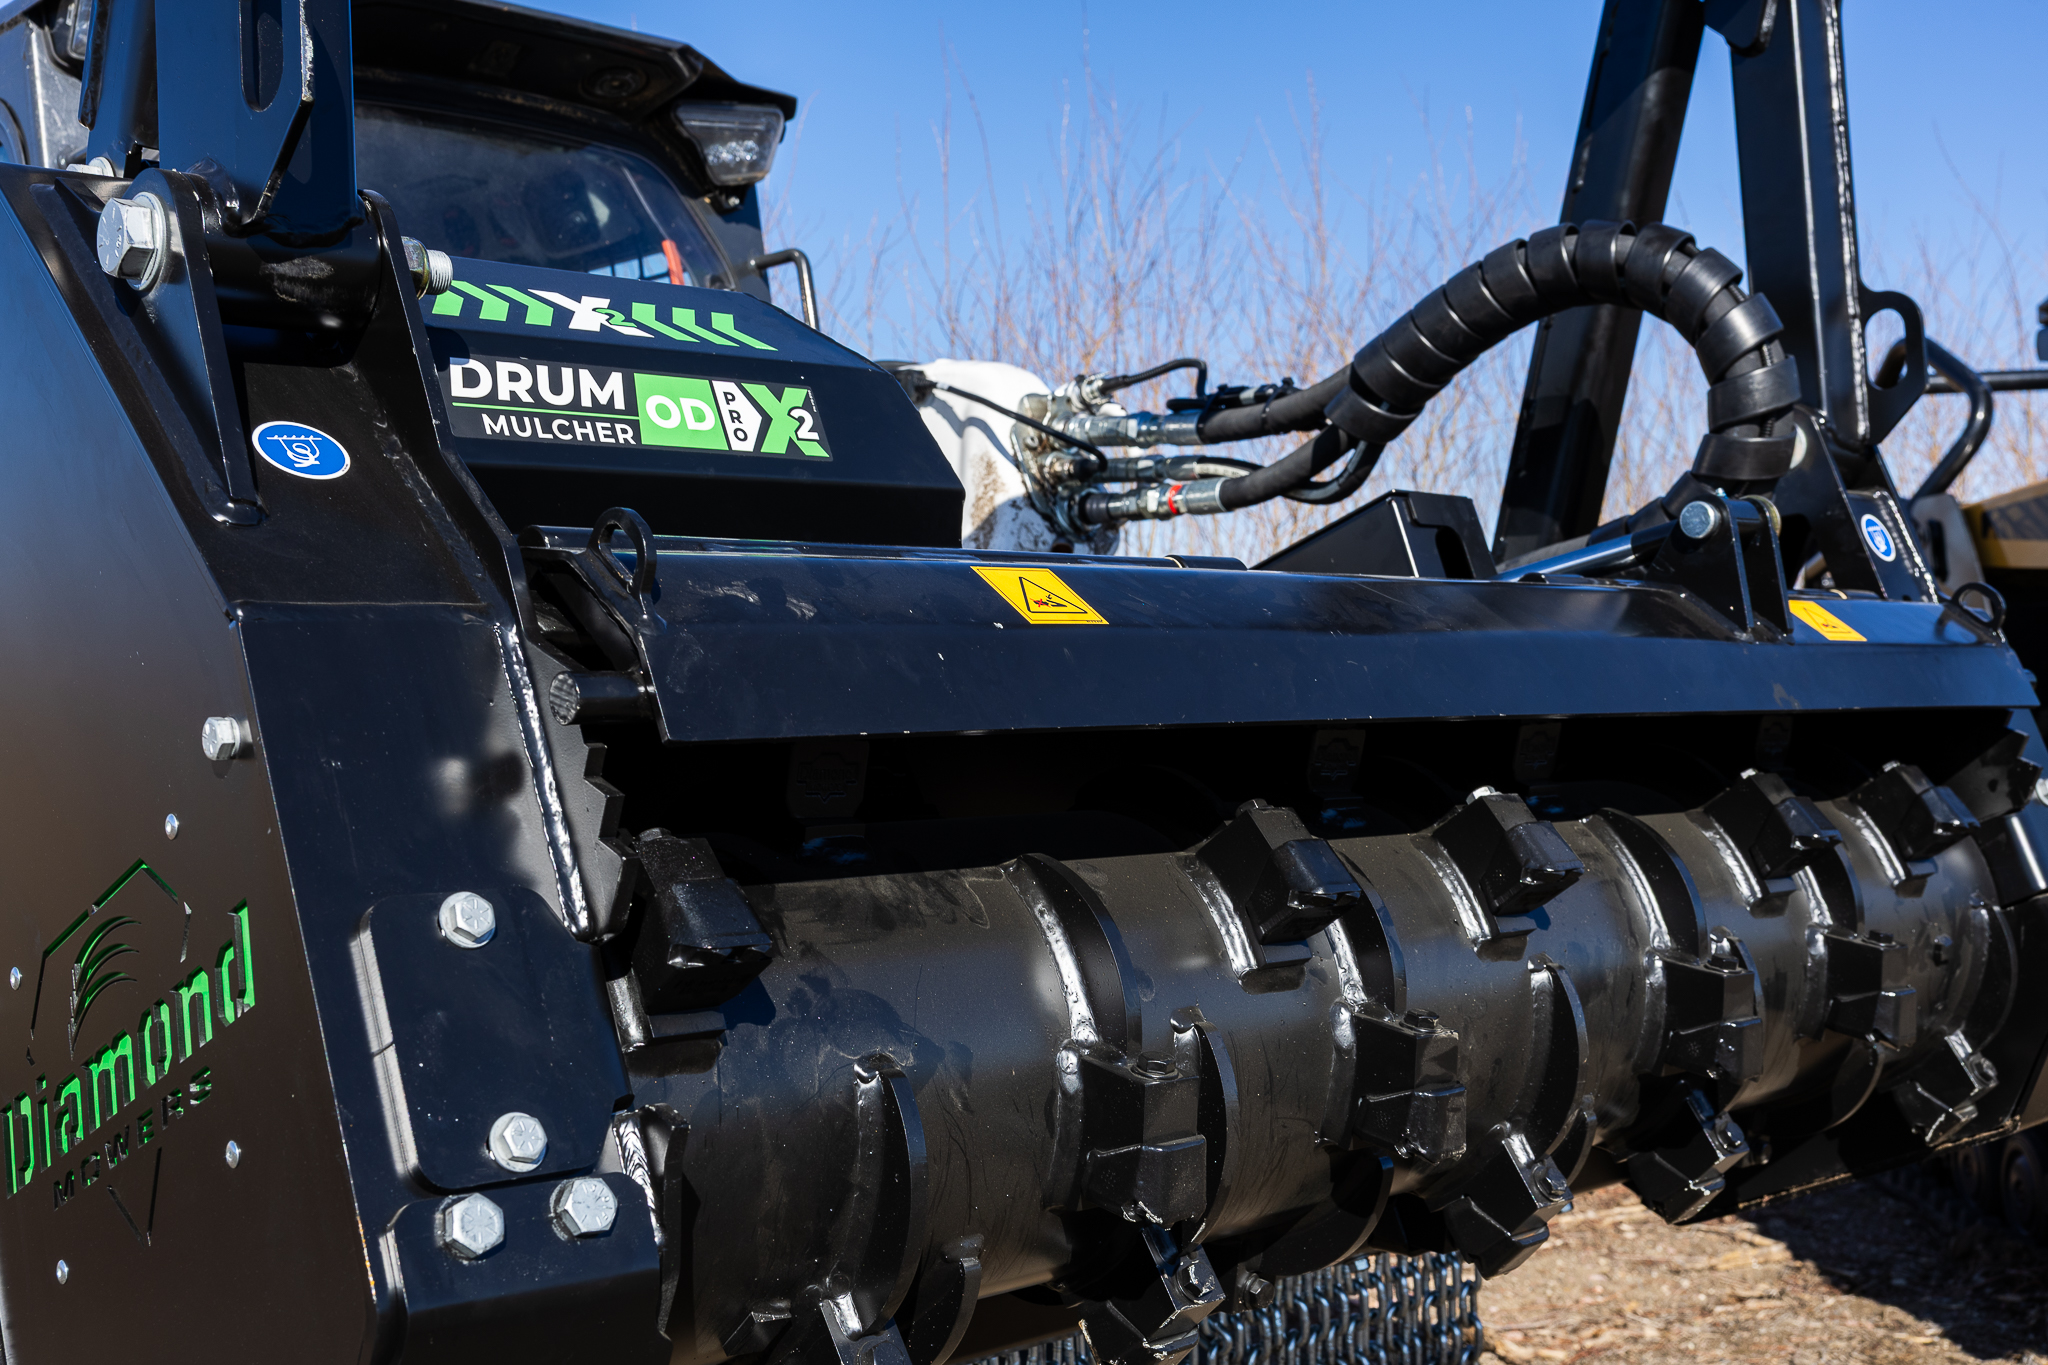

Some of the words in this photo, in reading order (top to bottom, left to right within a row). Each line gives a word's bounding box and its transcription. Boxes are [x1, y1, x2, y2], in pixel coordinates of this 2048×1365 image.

[449, 357, 627, 411] DRUM
[645, 394, 716, 432] OD
[722, 390, 749, 443] PRO
[740, 382, 830, 458] X2
[481, 413, 637, 446] MULCHER
[1, 897, 256, 1199] Diamond
[53, 1066, 213, 1211] MOWERS
